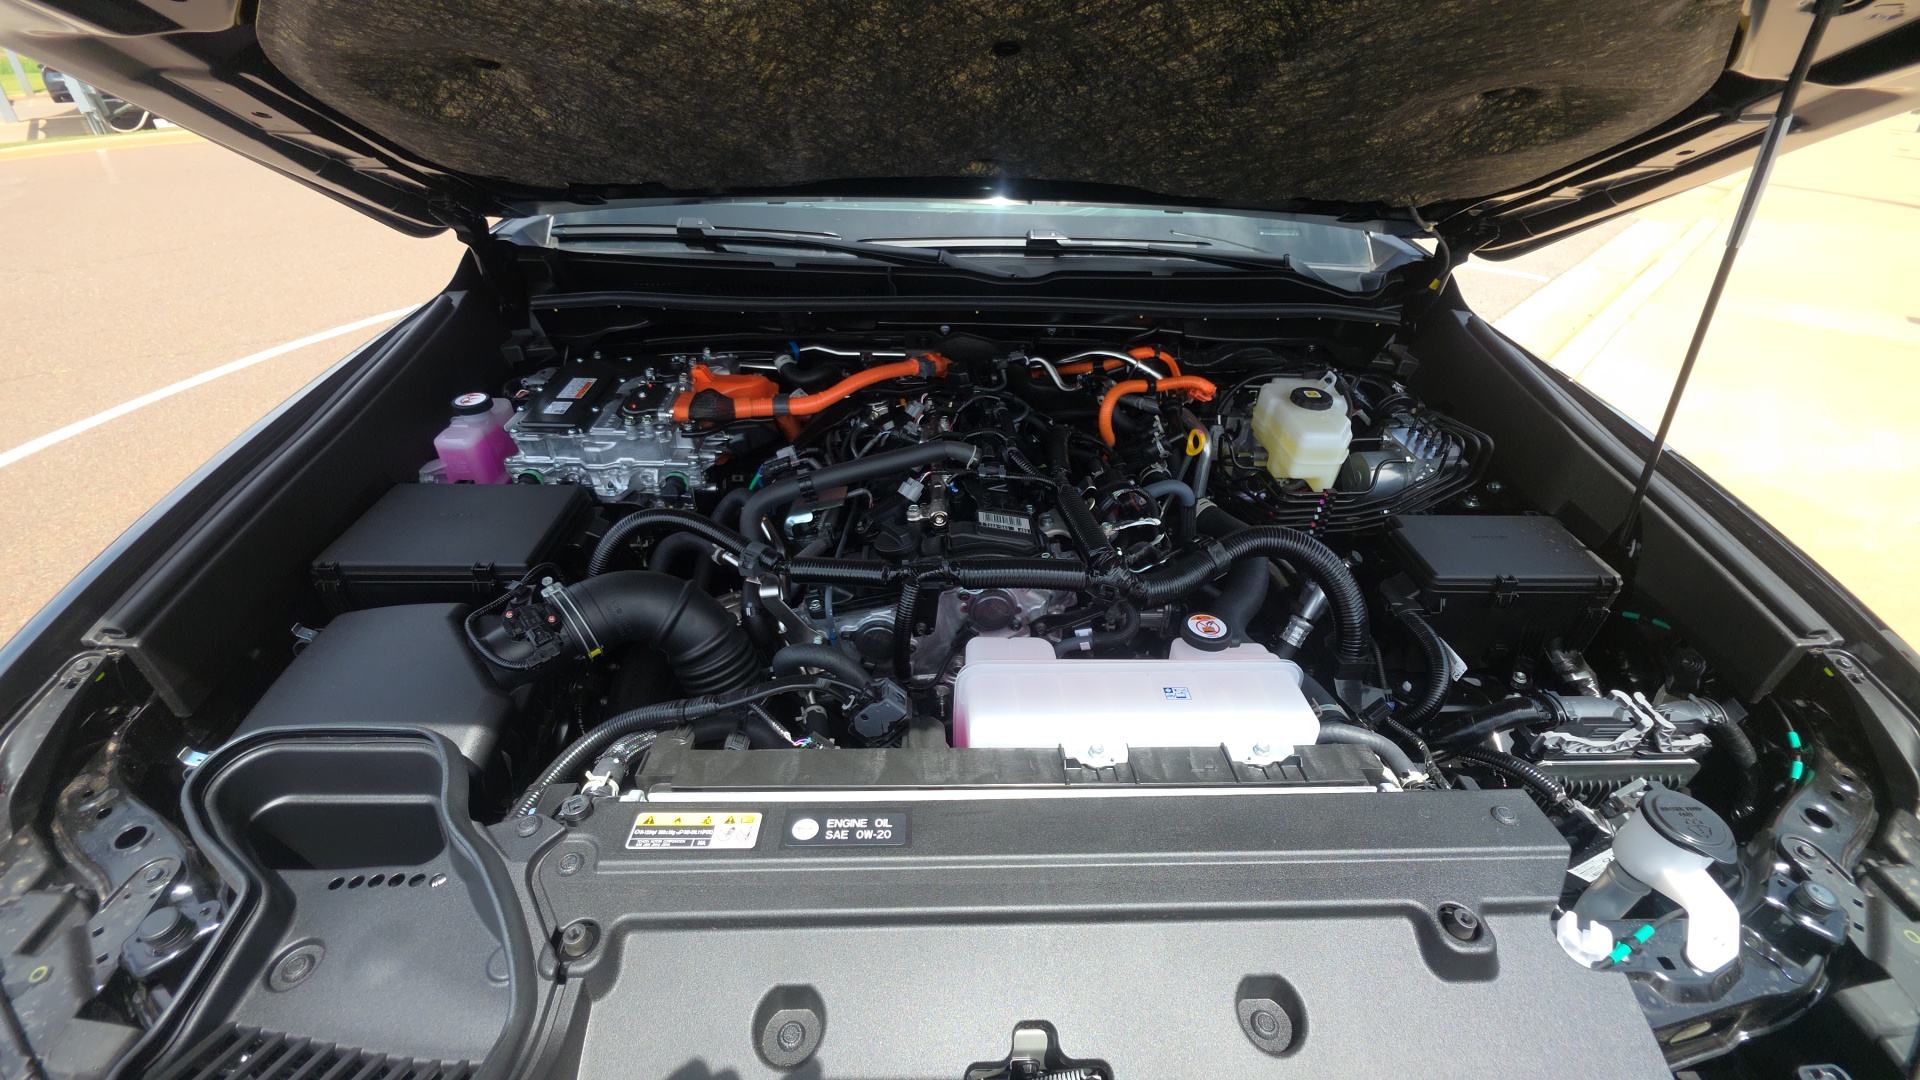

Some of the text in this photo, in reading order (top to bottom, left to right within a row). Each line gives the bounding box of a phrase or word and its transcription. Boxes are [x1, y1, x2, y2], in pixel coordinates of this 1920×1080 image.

[826, 818, 893, 828] ENGINE OIL
[825, 829, 892, 839] SAE 0W-20
